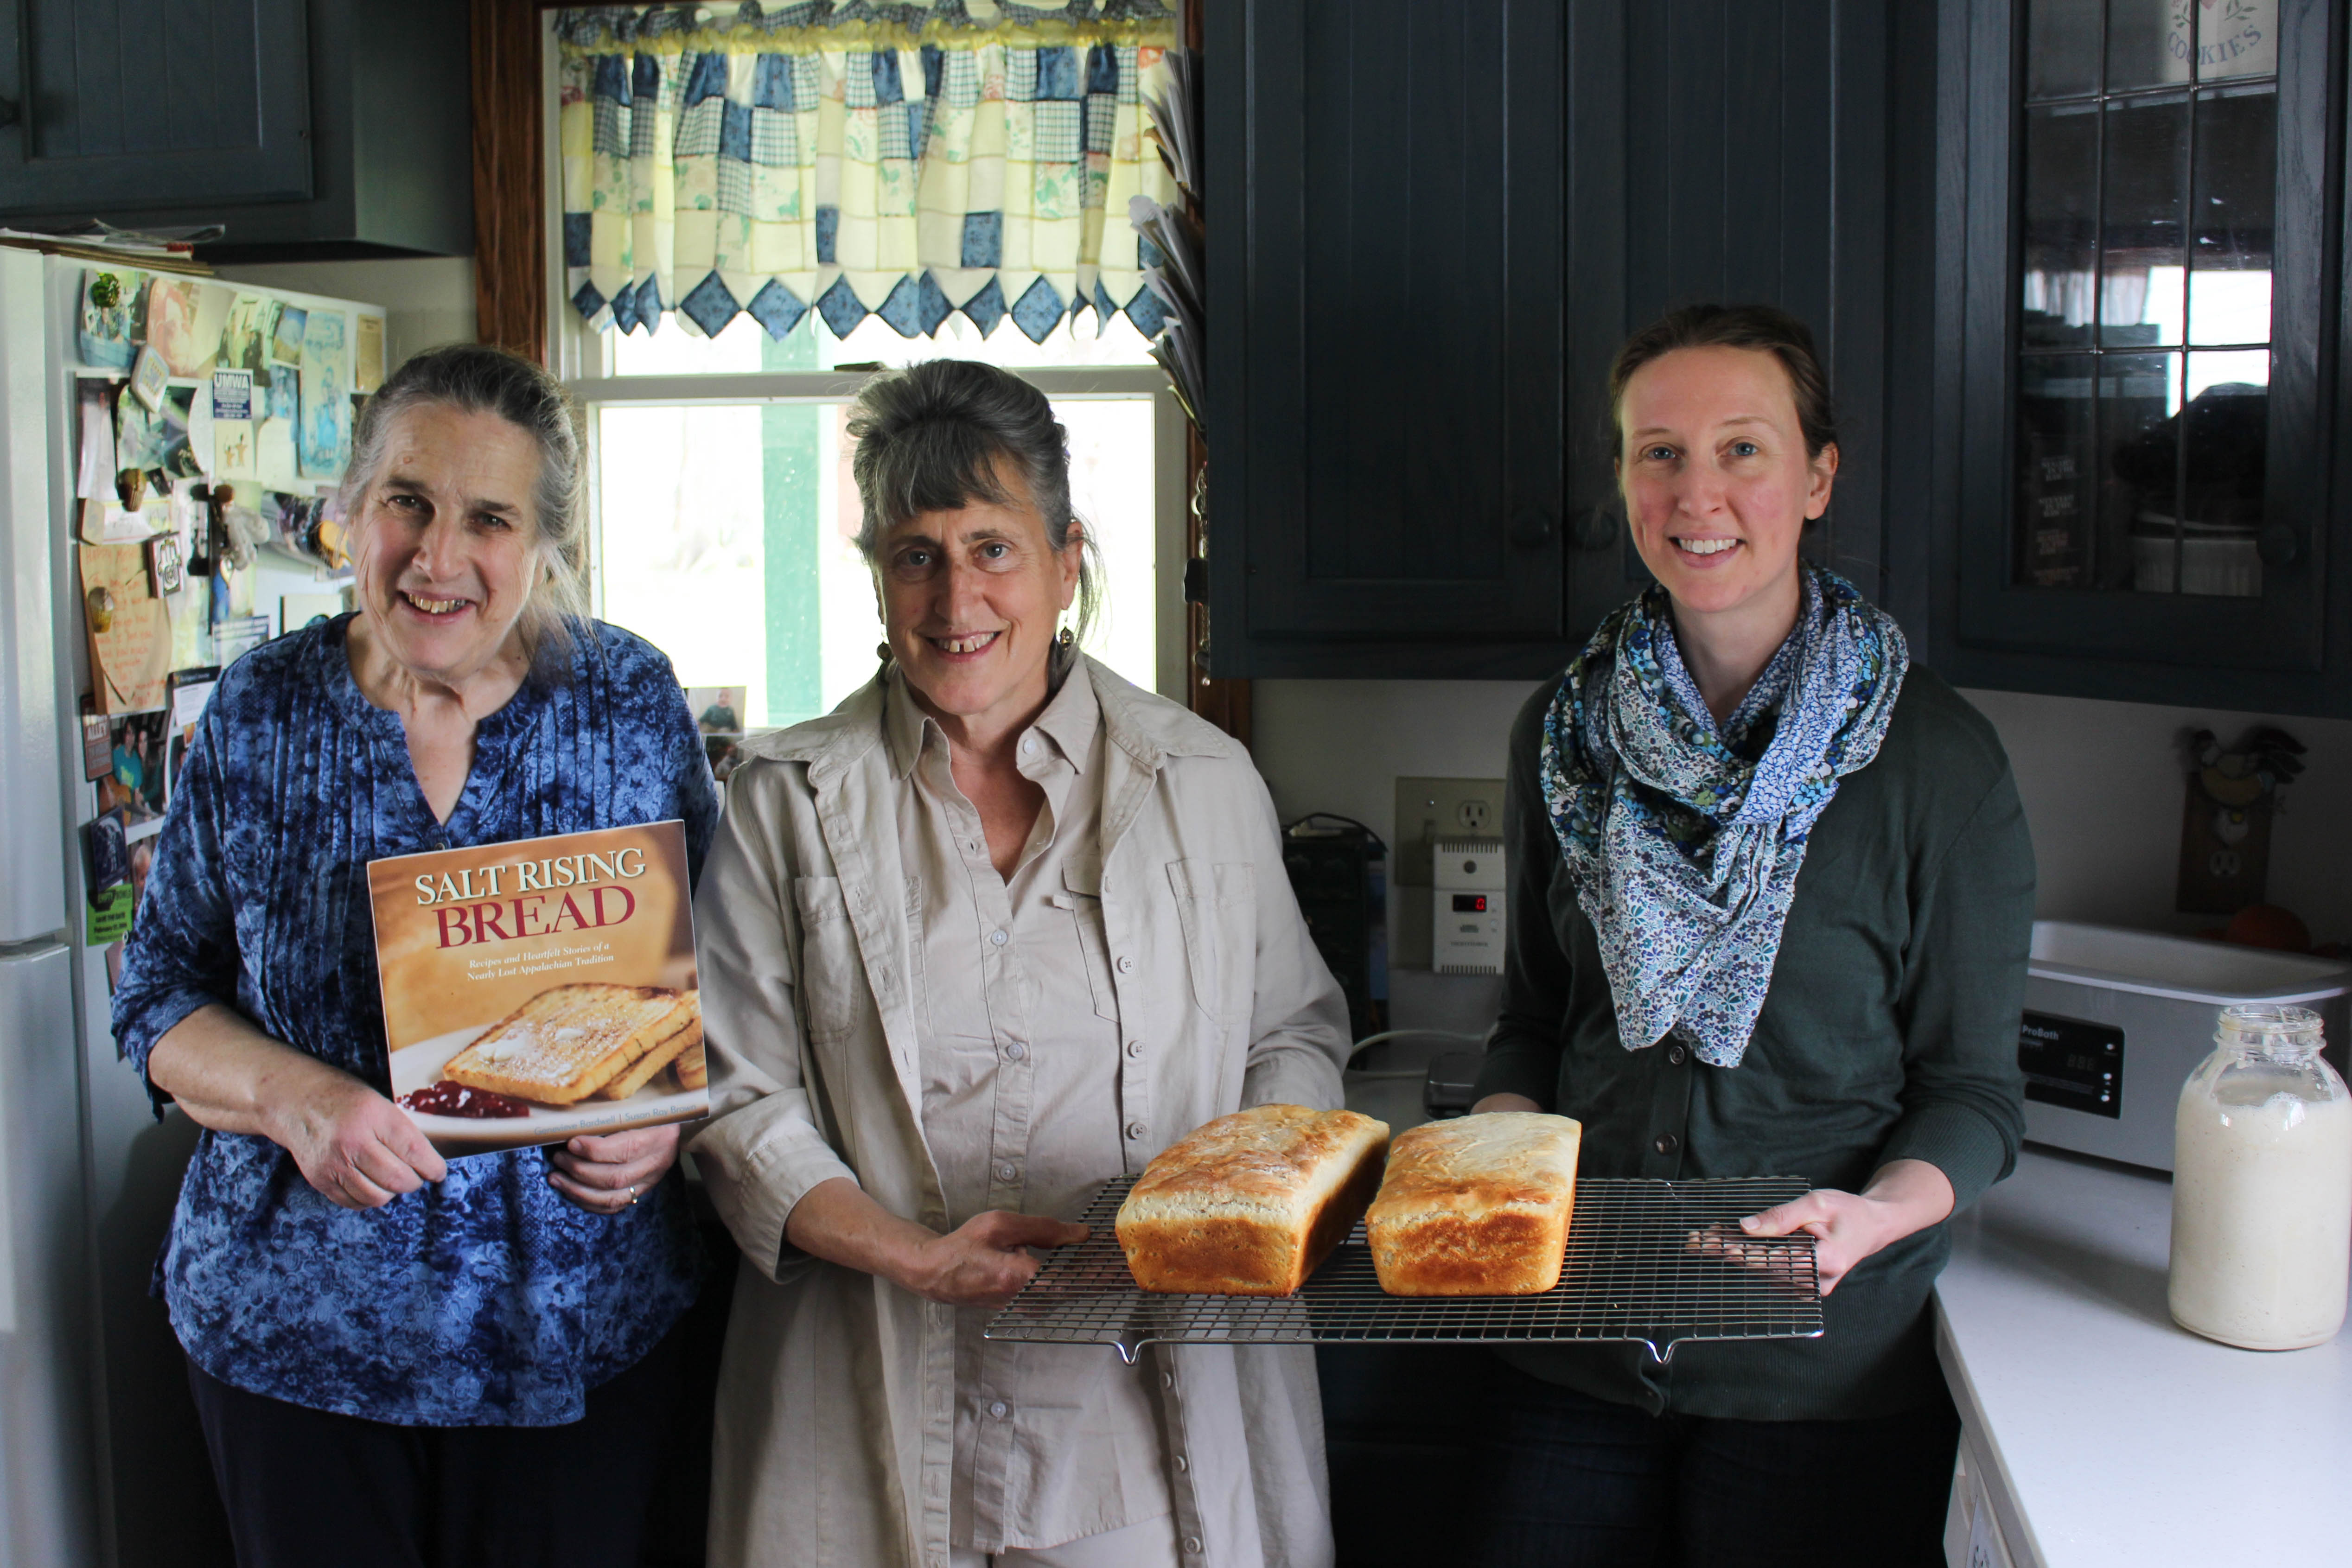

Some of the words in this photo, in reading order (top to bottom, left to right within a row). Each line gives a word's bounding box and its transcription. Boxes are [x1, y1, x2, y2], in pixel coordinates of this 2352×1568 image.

[215, 373, 249, 389] UMWA
[415, 865, 506, 905] SALT
[516, 848, 646, 892] RISING
[431, 885, 636, 949] BREAD
[467, 969, 496, 981] Nearly
[499, 967, 516, 977] Lost
[519, 960, 573, 976] Appalachian
[575, 954, 614, 966] Tradition
[469, 958, 502, 969] Recipes
[504, 953, 520, 964] and
[523, 948, 561, 961] Heartfelt
[563, 945, 591, 956] Stories
[593, 941, 603, 952] of
[2022, 1024, 2059, 1040] ProBath
[534, 1123, 577, 1135] Genevieve
[580, 1115, 616, 1128] Bardwell
[625, 1111, 650, 1122] Susan
[653, 1107, 668, 1116] Ray
[670, 1104, 697, 1114] Brown
